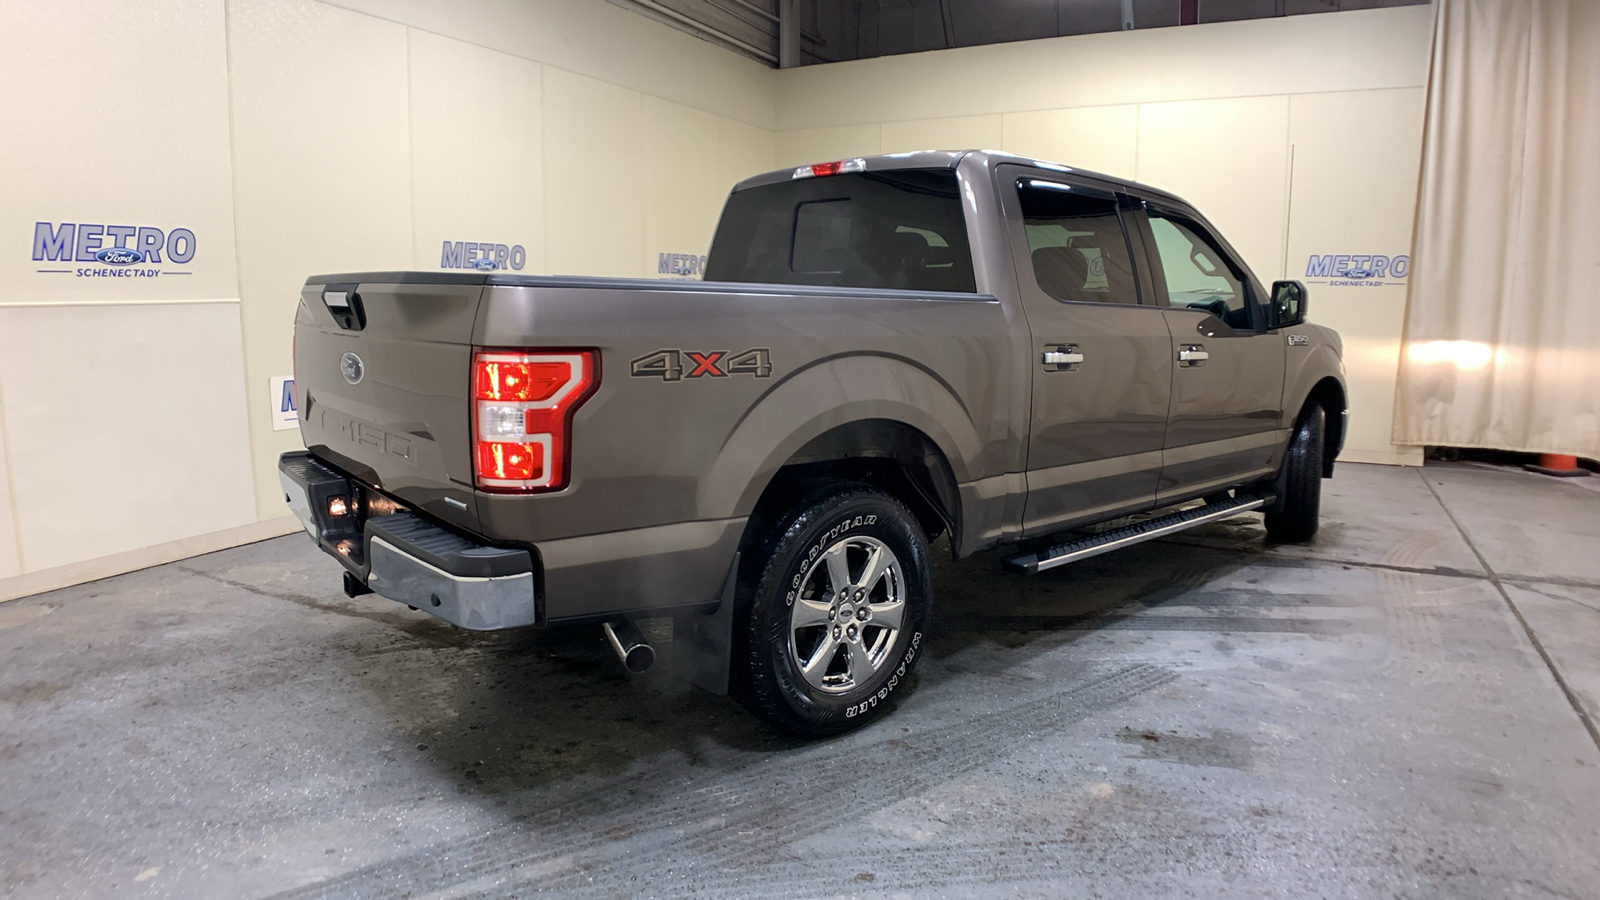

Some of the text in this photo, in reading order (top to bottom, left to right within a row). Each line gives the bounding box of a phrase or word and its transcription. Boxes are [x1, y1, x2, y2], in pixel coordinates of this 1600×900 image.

[32, 222, 196, 264] METRO
[105, 251, 134, 263] Ford
[441, 241, 526, 270] METRO
[76, 268, 160, 277] SCHENECTADY
[1305, 255, 1410, 278] METRO
[786, 515, 877, 606] GOODYEAR
[845, 632, 922, 718] WRANGLER
